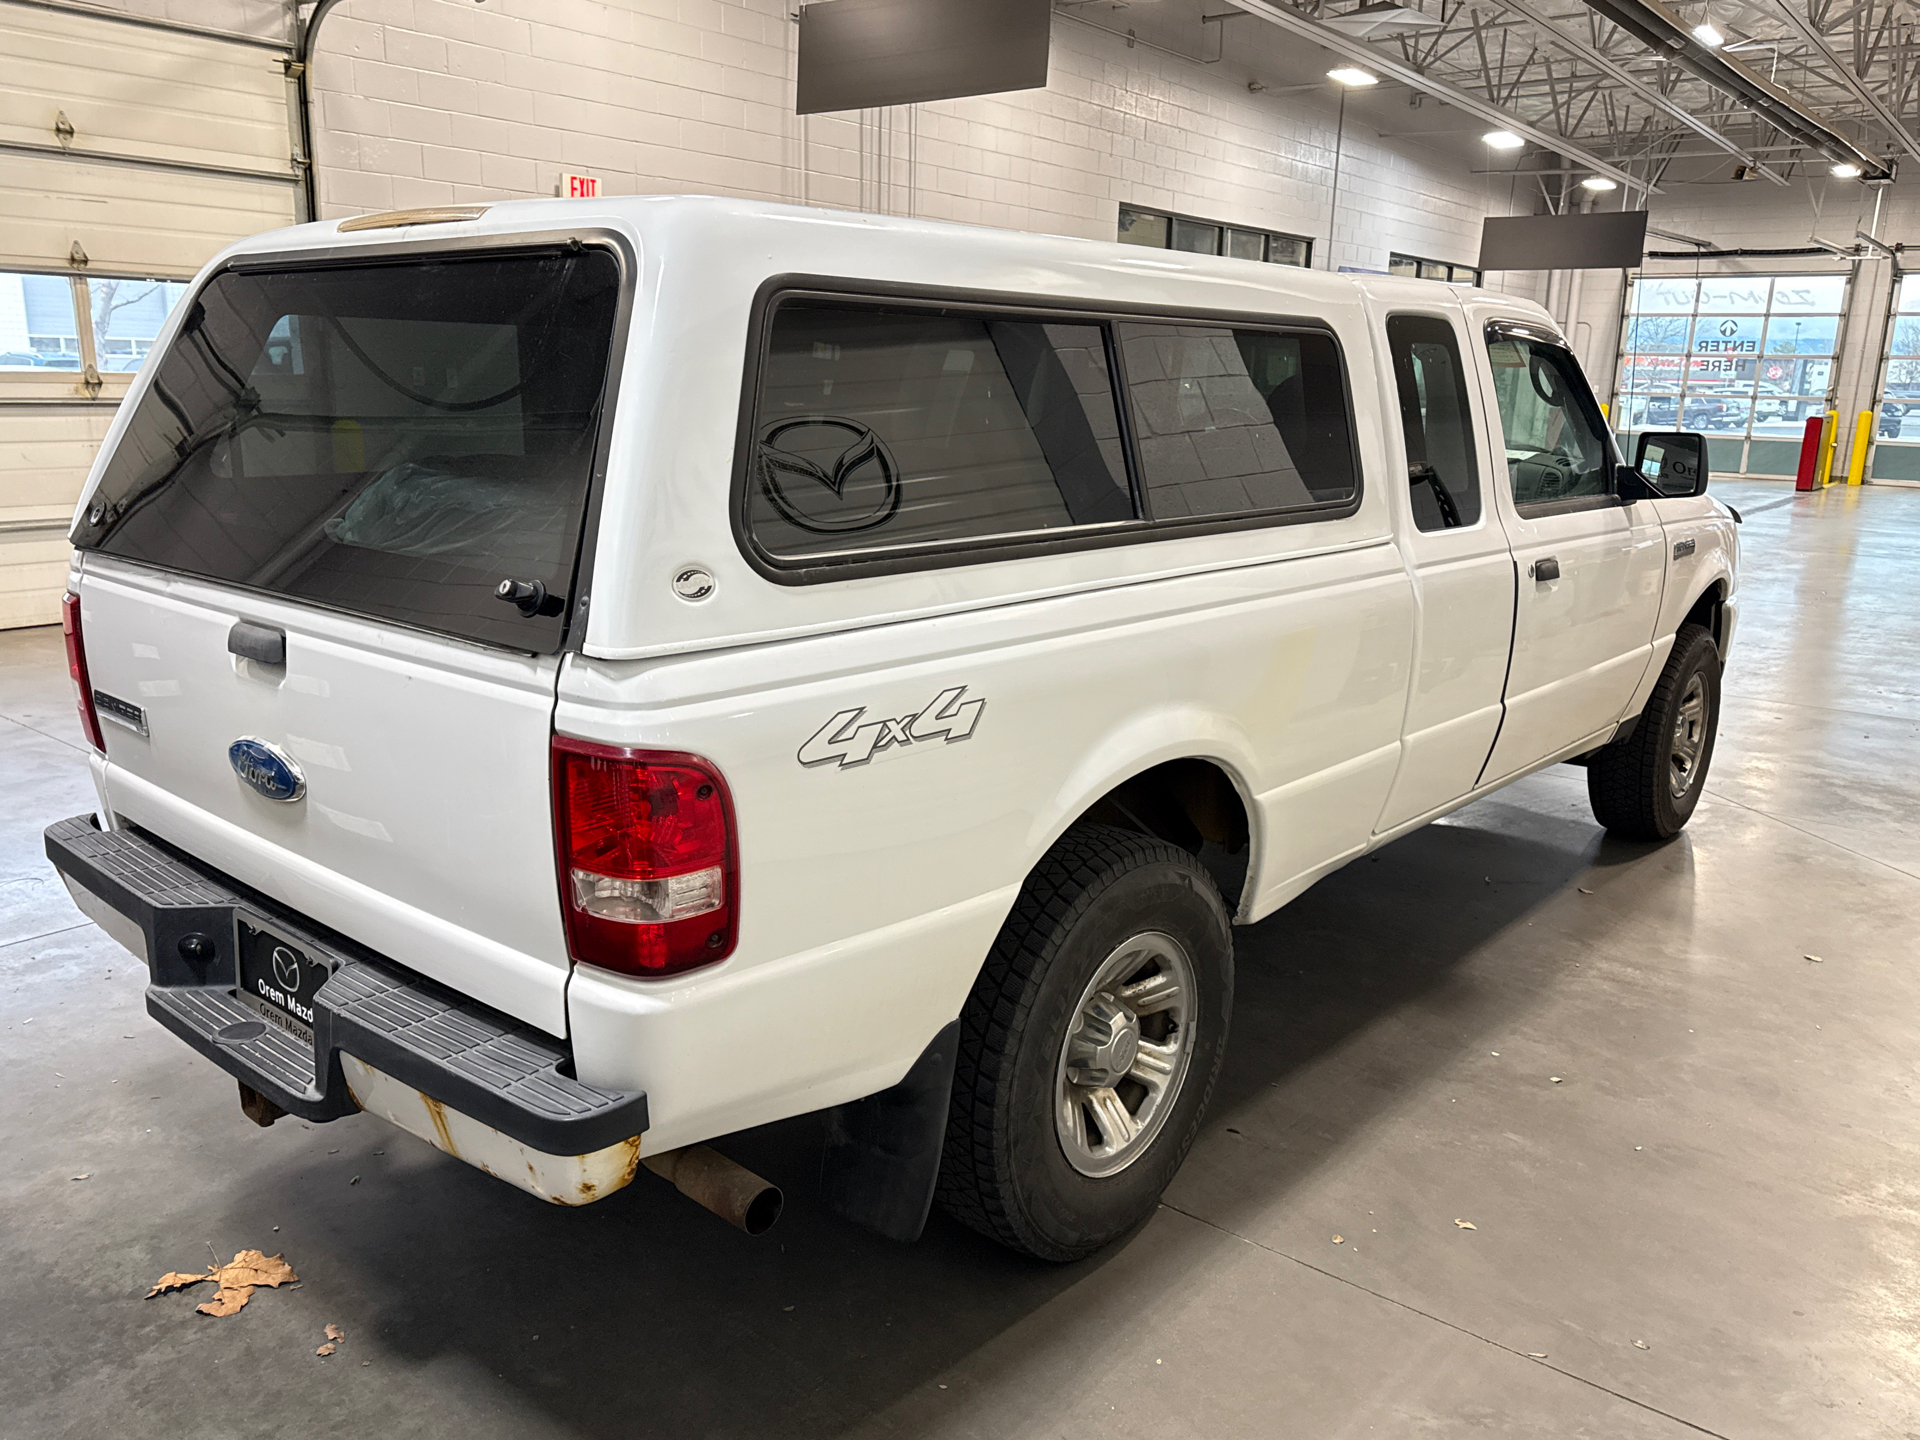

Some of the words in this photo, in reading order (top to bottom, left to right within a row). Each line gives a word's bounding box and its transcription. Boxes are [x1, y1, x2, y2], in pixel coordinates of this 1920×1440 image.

[570, 175, 596, 198] EXIT
[798, 685, 987, 771] 4x4
[239, 745, 288, 791] Ford
[258, 978, 285, 1007] Orem
[287, 994, 314, 1023] Mazd
[260, 1003, 283, 1027] Orem
[285, 1017, 313, 1046] Mazda
